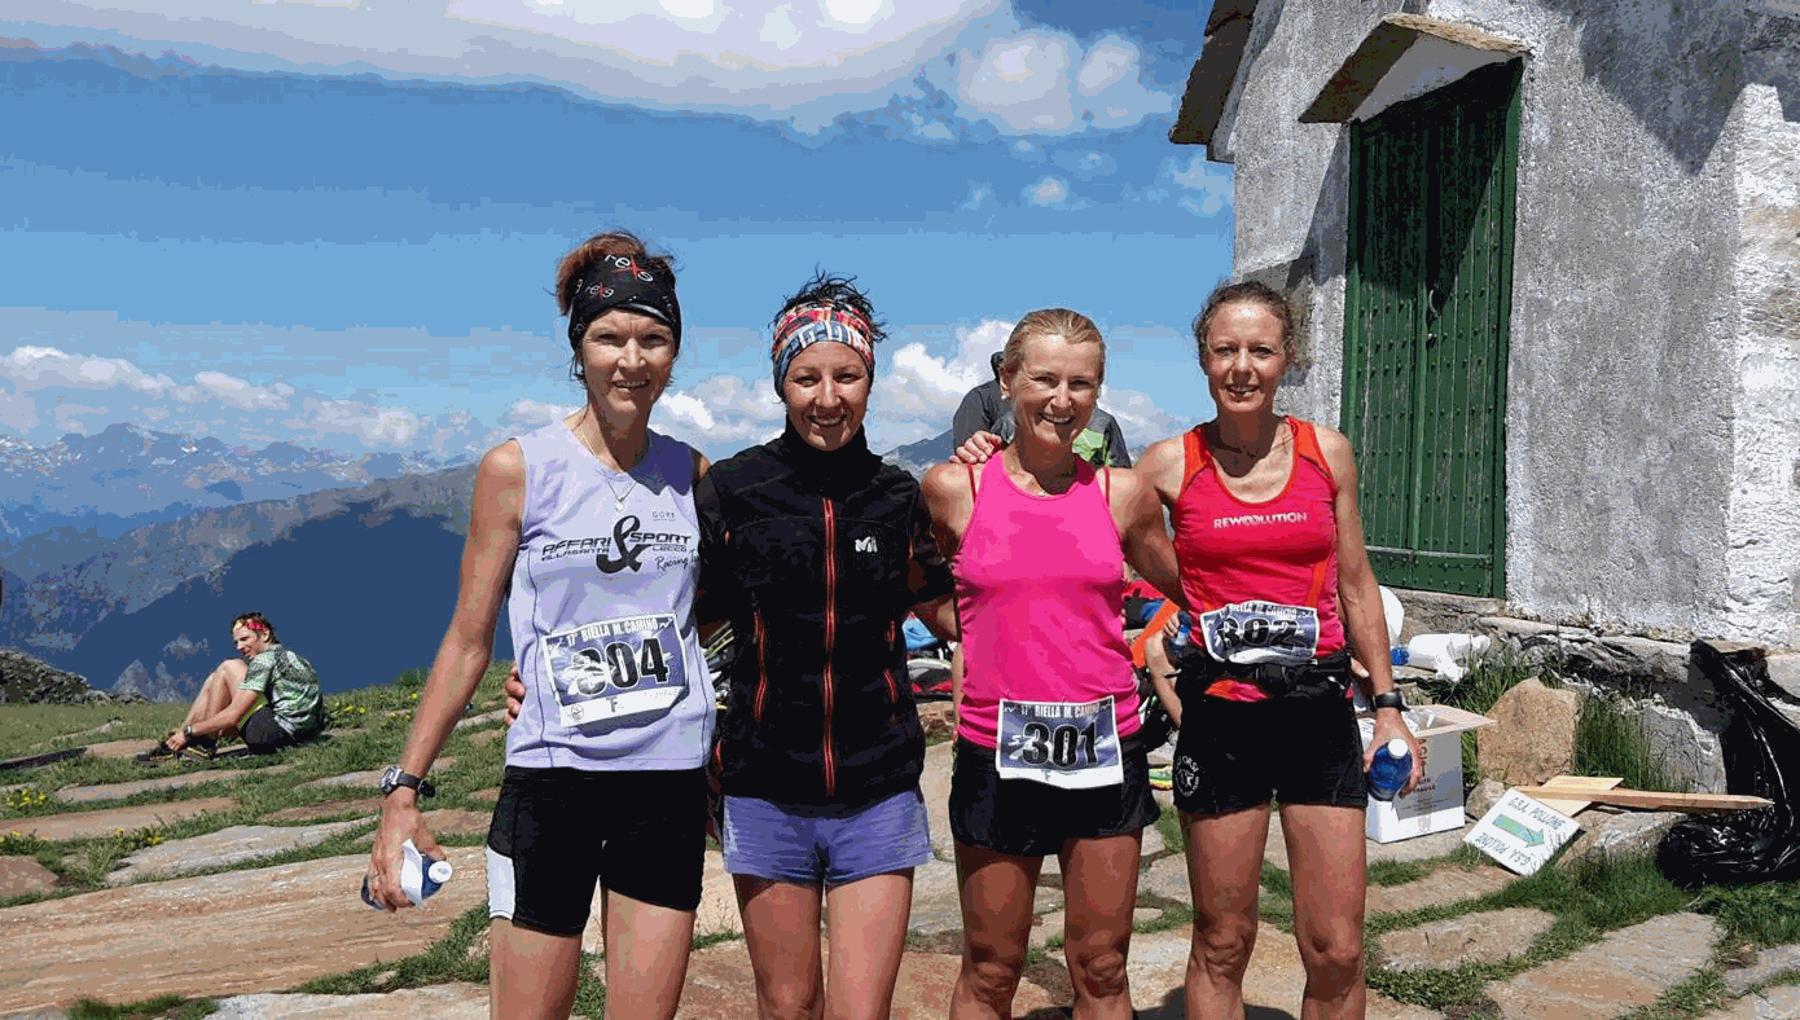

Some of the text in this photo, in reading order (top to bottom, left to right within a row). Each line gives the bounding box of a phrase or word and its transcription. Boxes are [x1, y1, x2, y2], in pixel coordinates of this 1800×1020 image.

[542, 515, 691, 574] AFFARI & SPORT
[581, 624, 611, 642] BIELLA
[624, 618, 658, 634] CAMINO
[572, 637, 670, 696] 304
[1035, 704, 1060, 718] BIELLA
[1022, 720, 1098, 768] 301
